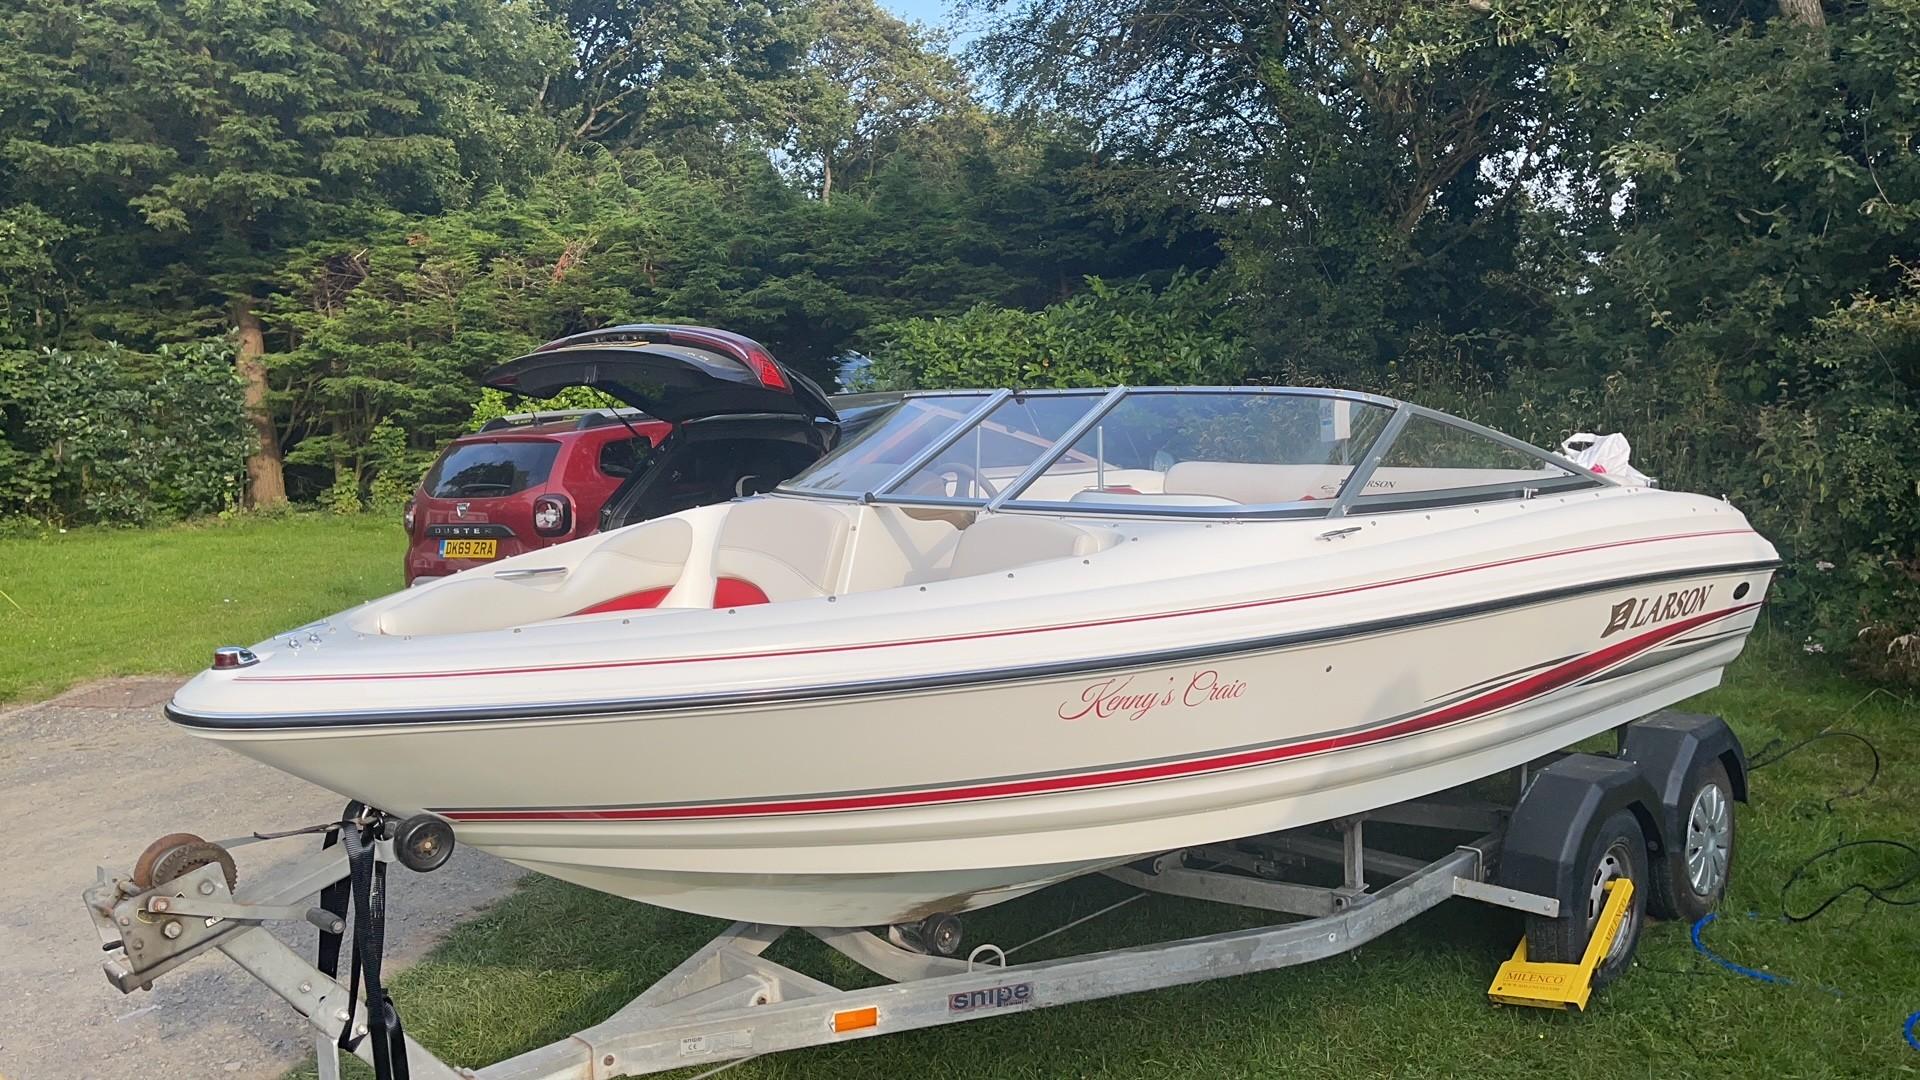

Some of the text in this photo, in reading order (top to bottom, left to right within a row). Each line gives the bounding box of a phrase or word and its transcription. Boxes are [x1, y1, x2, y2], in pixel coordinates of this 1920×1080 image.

[435, 527, 492, 535] DUSTER
[445, 541, 493, 555] DK69 ZRA
[1630, 584, 1714, 629] LARSON
[1058, 670, 1247, 720] Kenny's Craic
[1506, 972, 1563, 985] MILENCO
[954, 983, 1029, 1009] snipe
